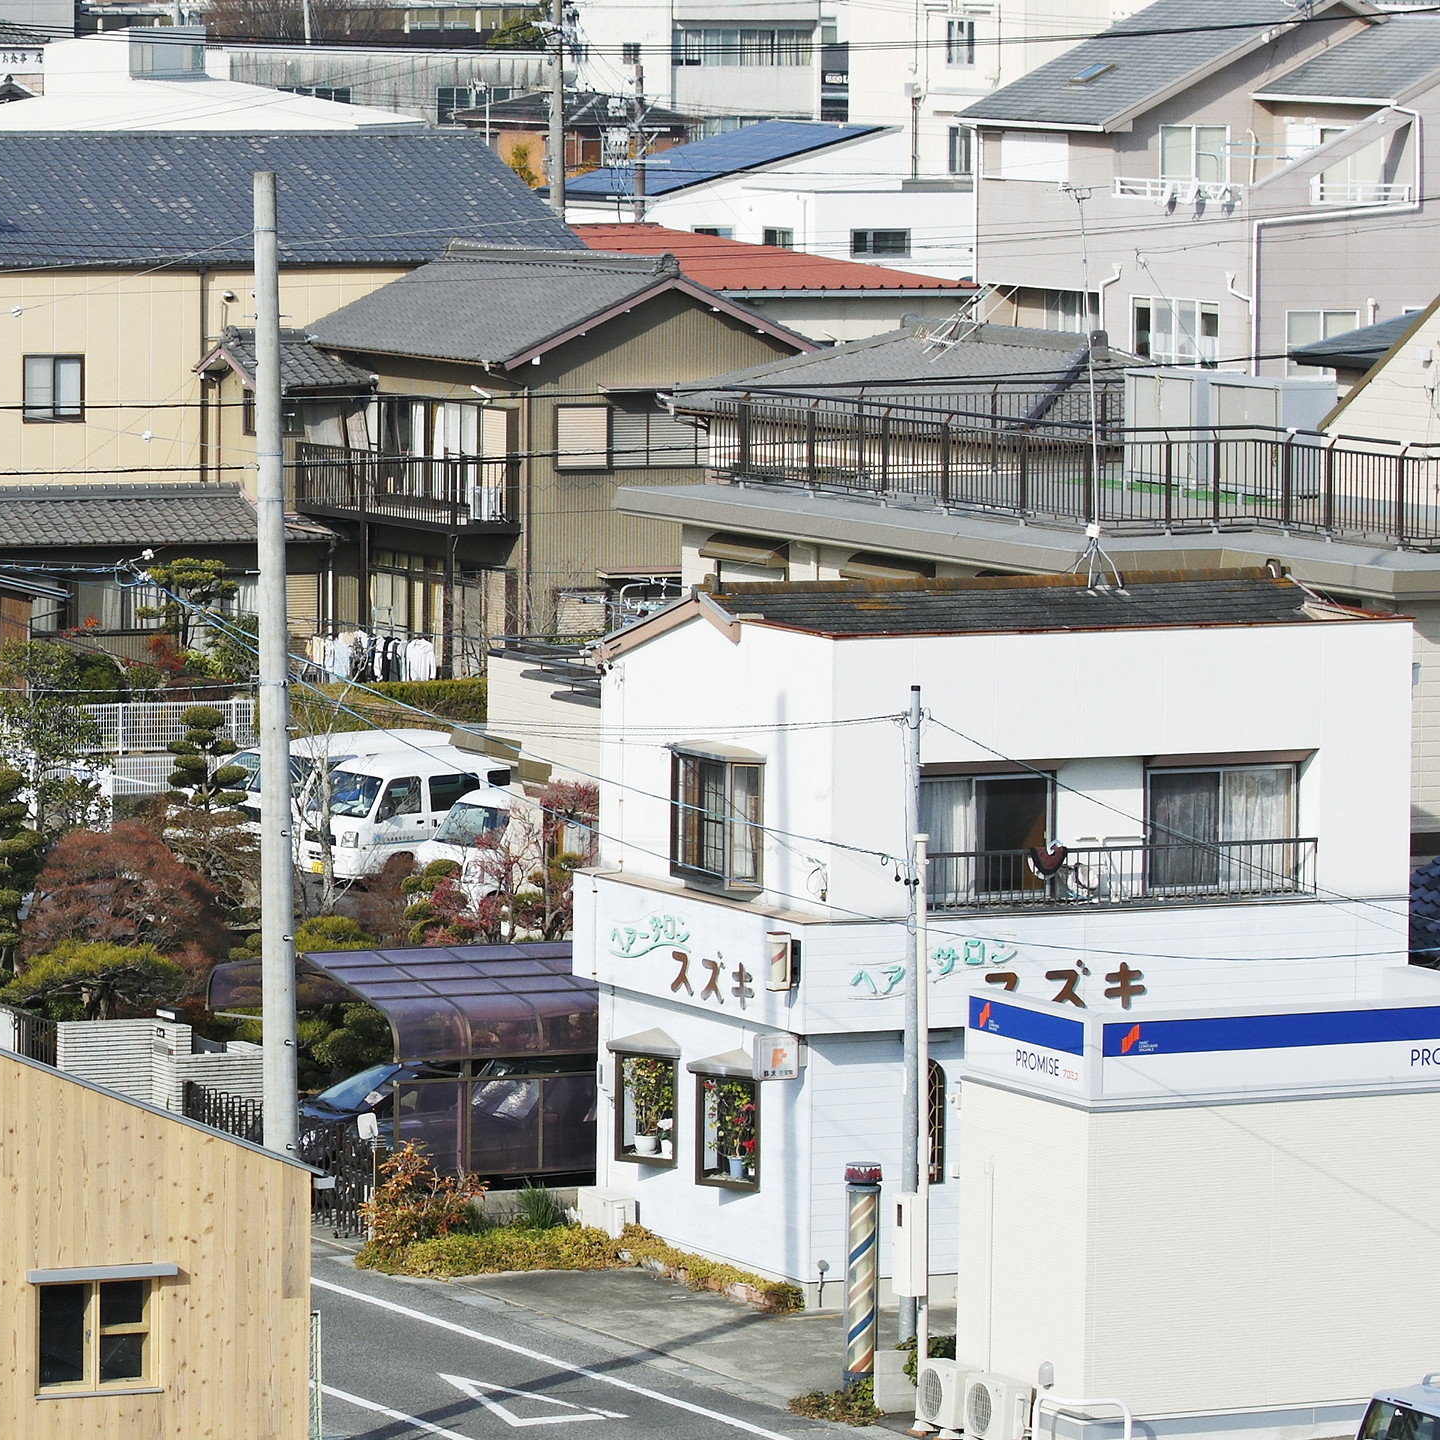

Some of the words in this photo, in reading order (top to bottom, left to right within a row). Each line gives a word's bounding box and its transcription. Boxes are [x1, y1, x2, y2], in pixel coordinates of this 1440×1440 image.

[671, 951, 755, 1010] スズキ
[850, 939, 1017, 995] ヘアサロン
[1016, 1049, 1060, 1077] PROMISE
